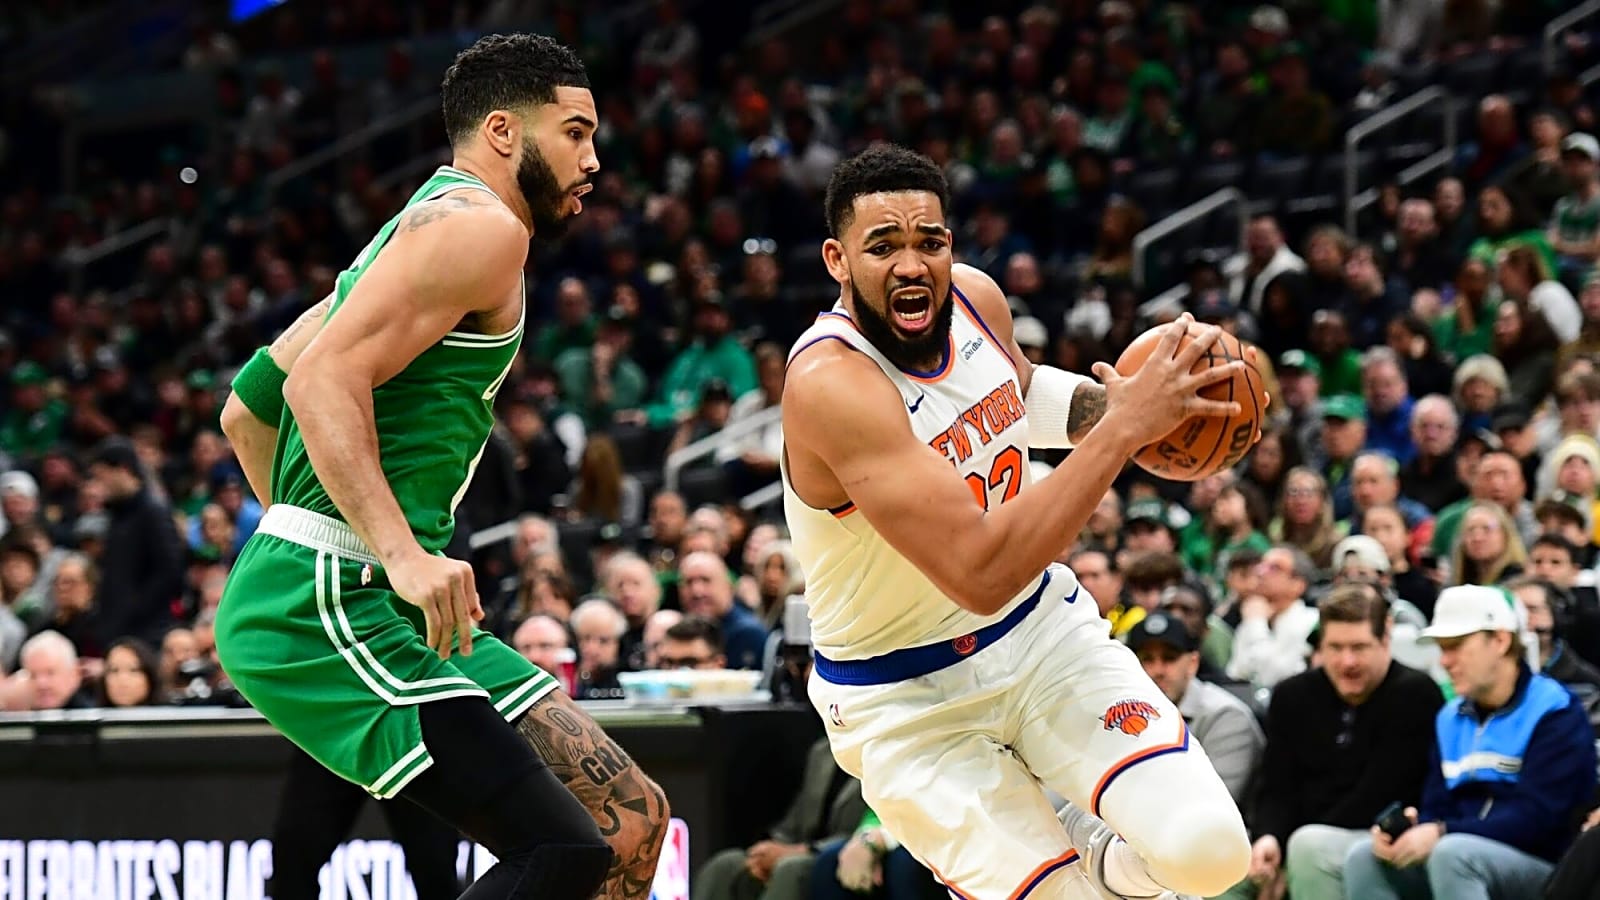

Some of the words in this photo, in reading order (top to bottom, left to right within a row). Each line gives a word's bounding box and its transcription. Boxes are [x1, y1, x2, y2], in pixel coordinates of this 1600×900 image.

[928, 416, 973, 467] EW
[962, 379, 1026, 446] YORK
[1103, 701, 1161, 731] KNICKS
[0, 839, 181, 900] ELEBRATES
[183, 839, 274, 900] BLAC
